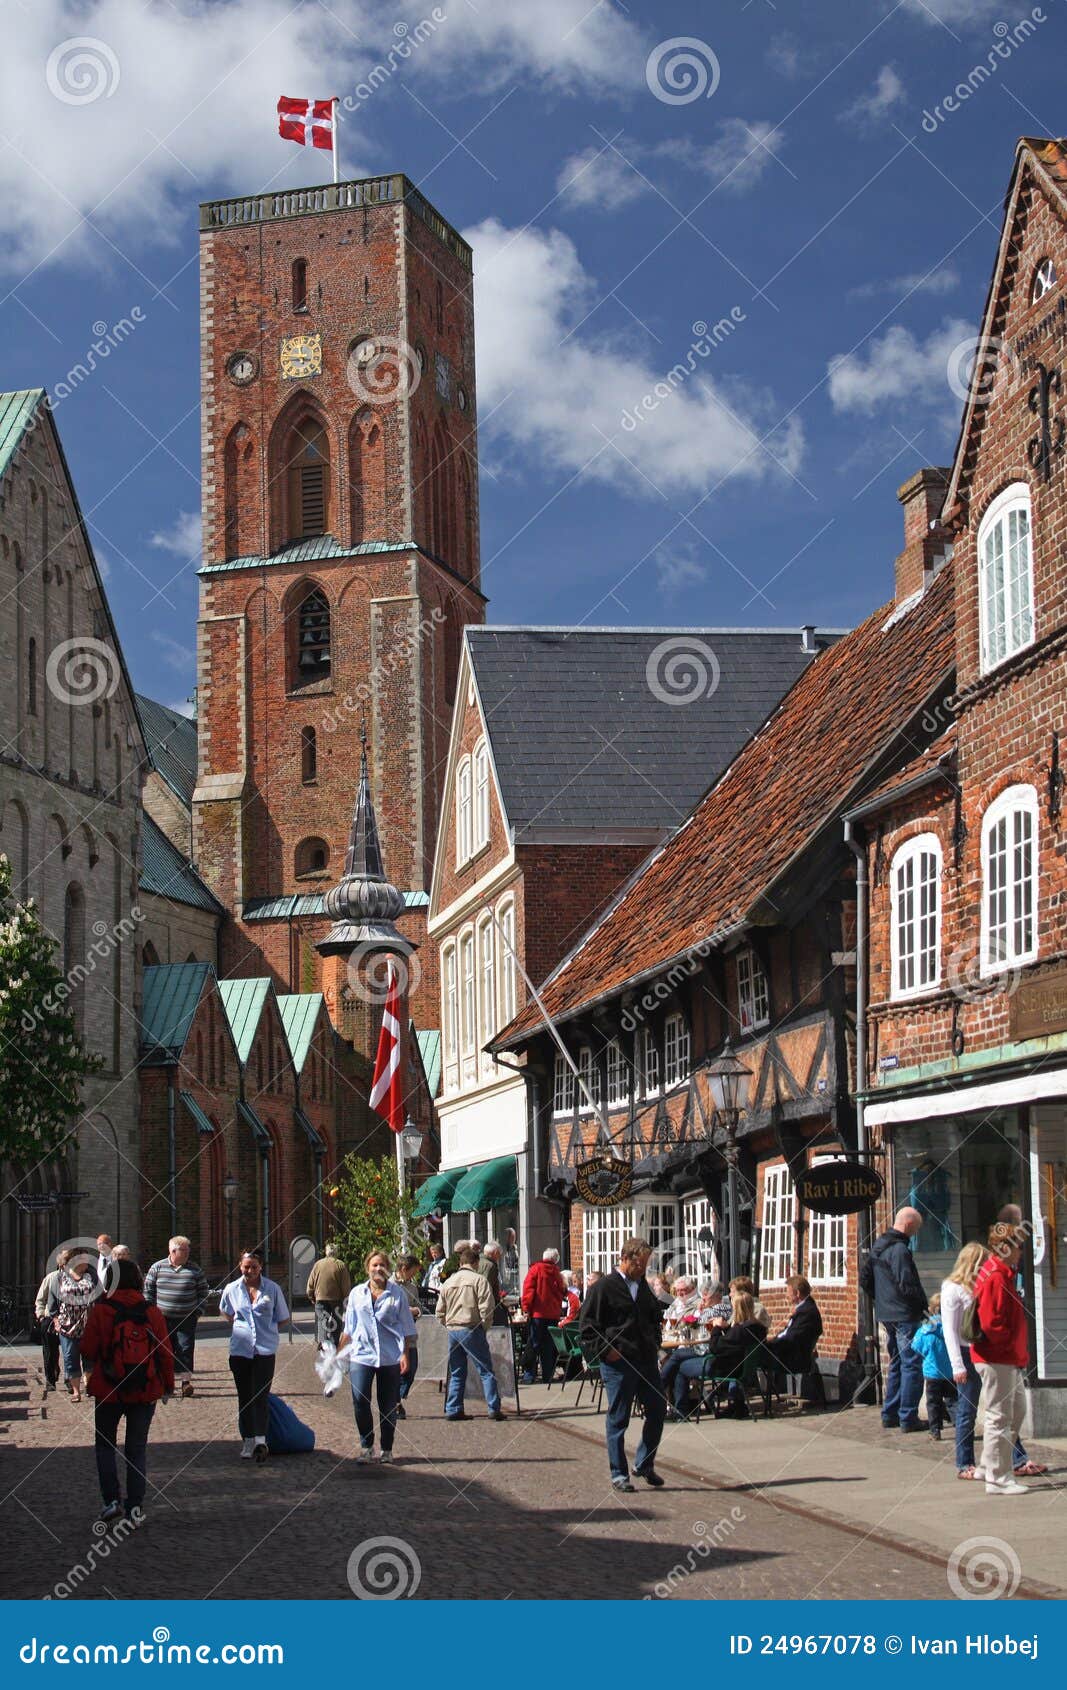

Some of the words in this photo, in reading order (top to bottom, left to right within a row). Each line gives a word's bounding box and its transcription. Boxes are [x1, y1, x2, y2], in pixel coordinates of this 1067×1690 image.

[803, 1182, 830, 1199] Rav
[834, 1180, 839, 1197] i
[843, 1178, 877, 1197] Ribe
